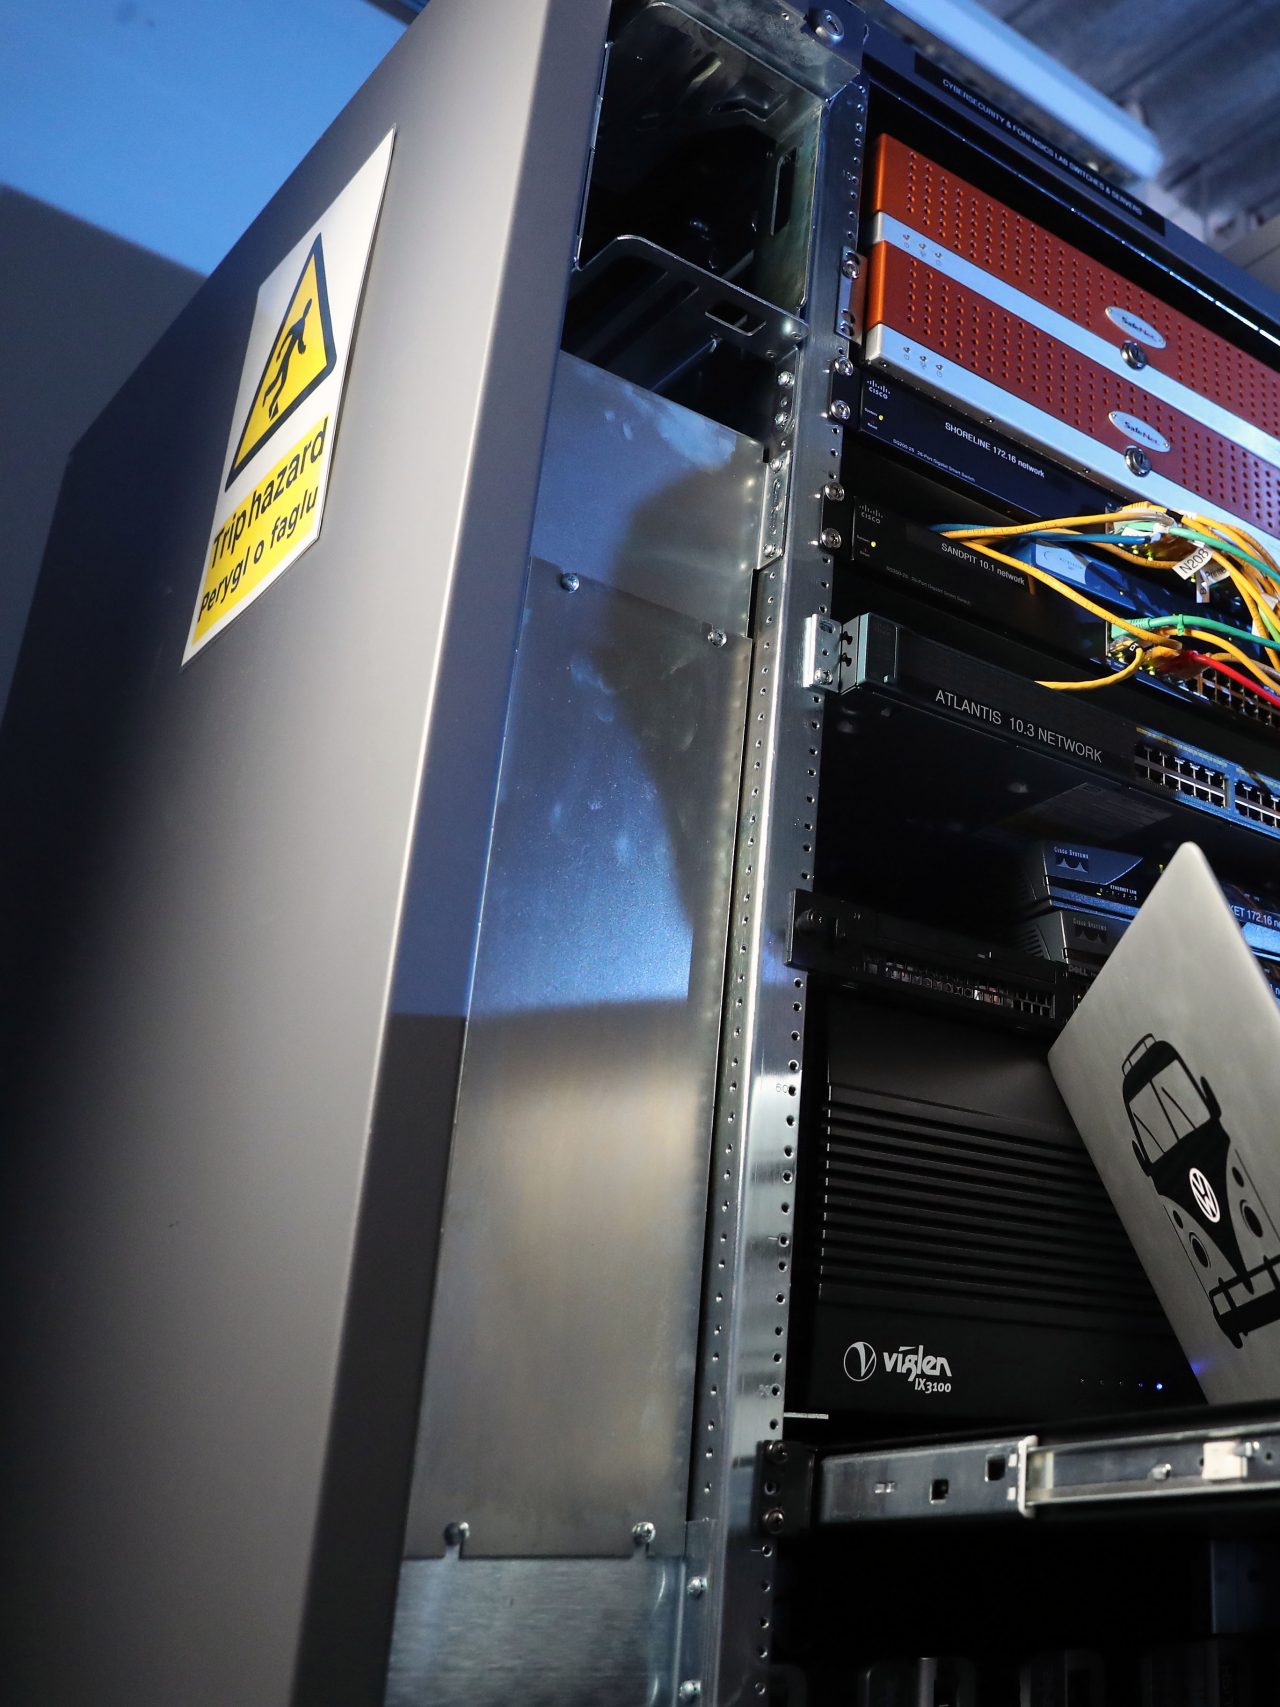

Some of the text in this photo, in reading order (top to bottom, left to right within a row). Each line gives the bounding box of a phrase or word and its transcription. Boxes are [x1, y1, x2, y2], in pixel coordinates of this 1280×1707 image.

[942, 78, 1006, 124] CYBERSECURITY
[1013, 124, 1054, 157] FORENSICS
[1054, 152, 1069, 167] LAB
[1069, 160, 1105, 191] SWITCHES
[1111, 191, 1142, 216] SERVERS
[868, 386, 888, 400] CISCO
[1124, 421, 1158, 444] SafeNet
[945, 422, 1045, 478] SHORELINE 172.16 network
[212, 416, 328, 568] Trip hazard
[861, 511, 881, 524] CISCO
[197, 485, 319, 623] Perygl o faglu
[941, 542, 1025, 586] SANDPIT 10.1 network
[1179, 548, 1209, 574] N208
[1205, 567, 1227, 580] Printe
[935, 689, 1102, 763] ATLANTIS 10.3 NETWORK
[1247, 910, 1273, 926] 172.16
[883, 1345, 952, 1382] viglen
[915, 1378, 952, 1394] IX3100
